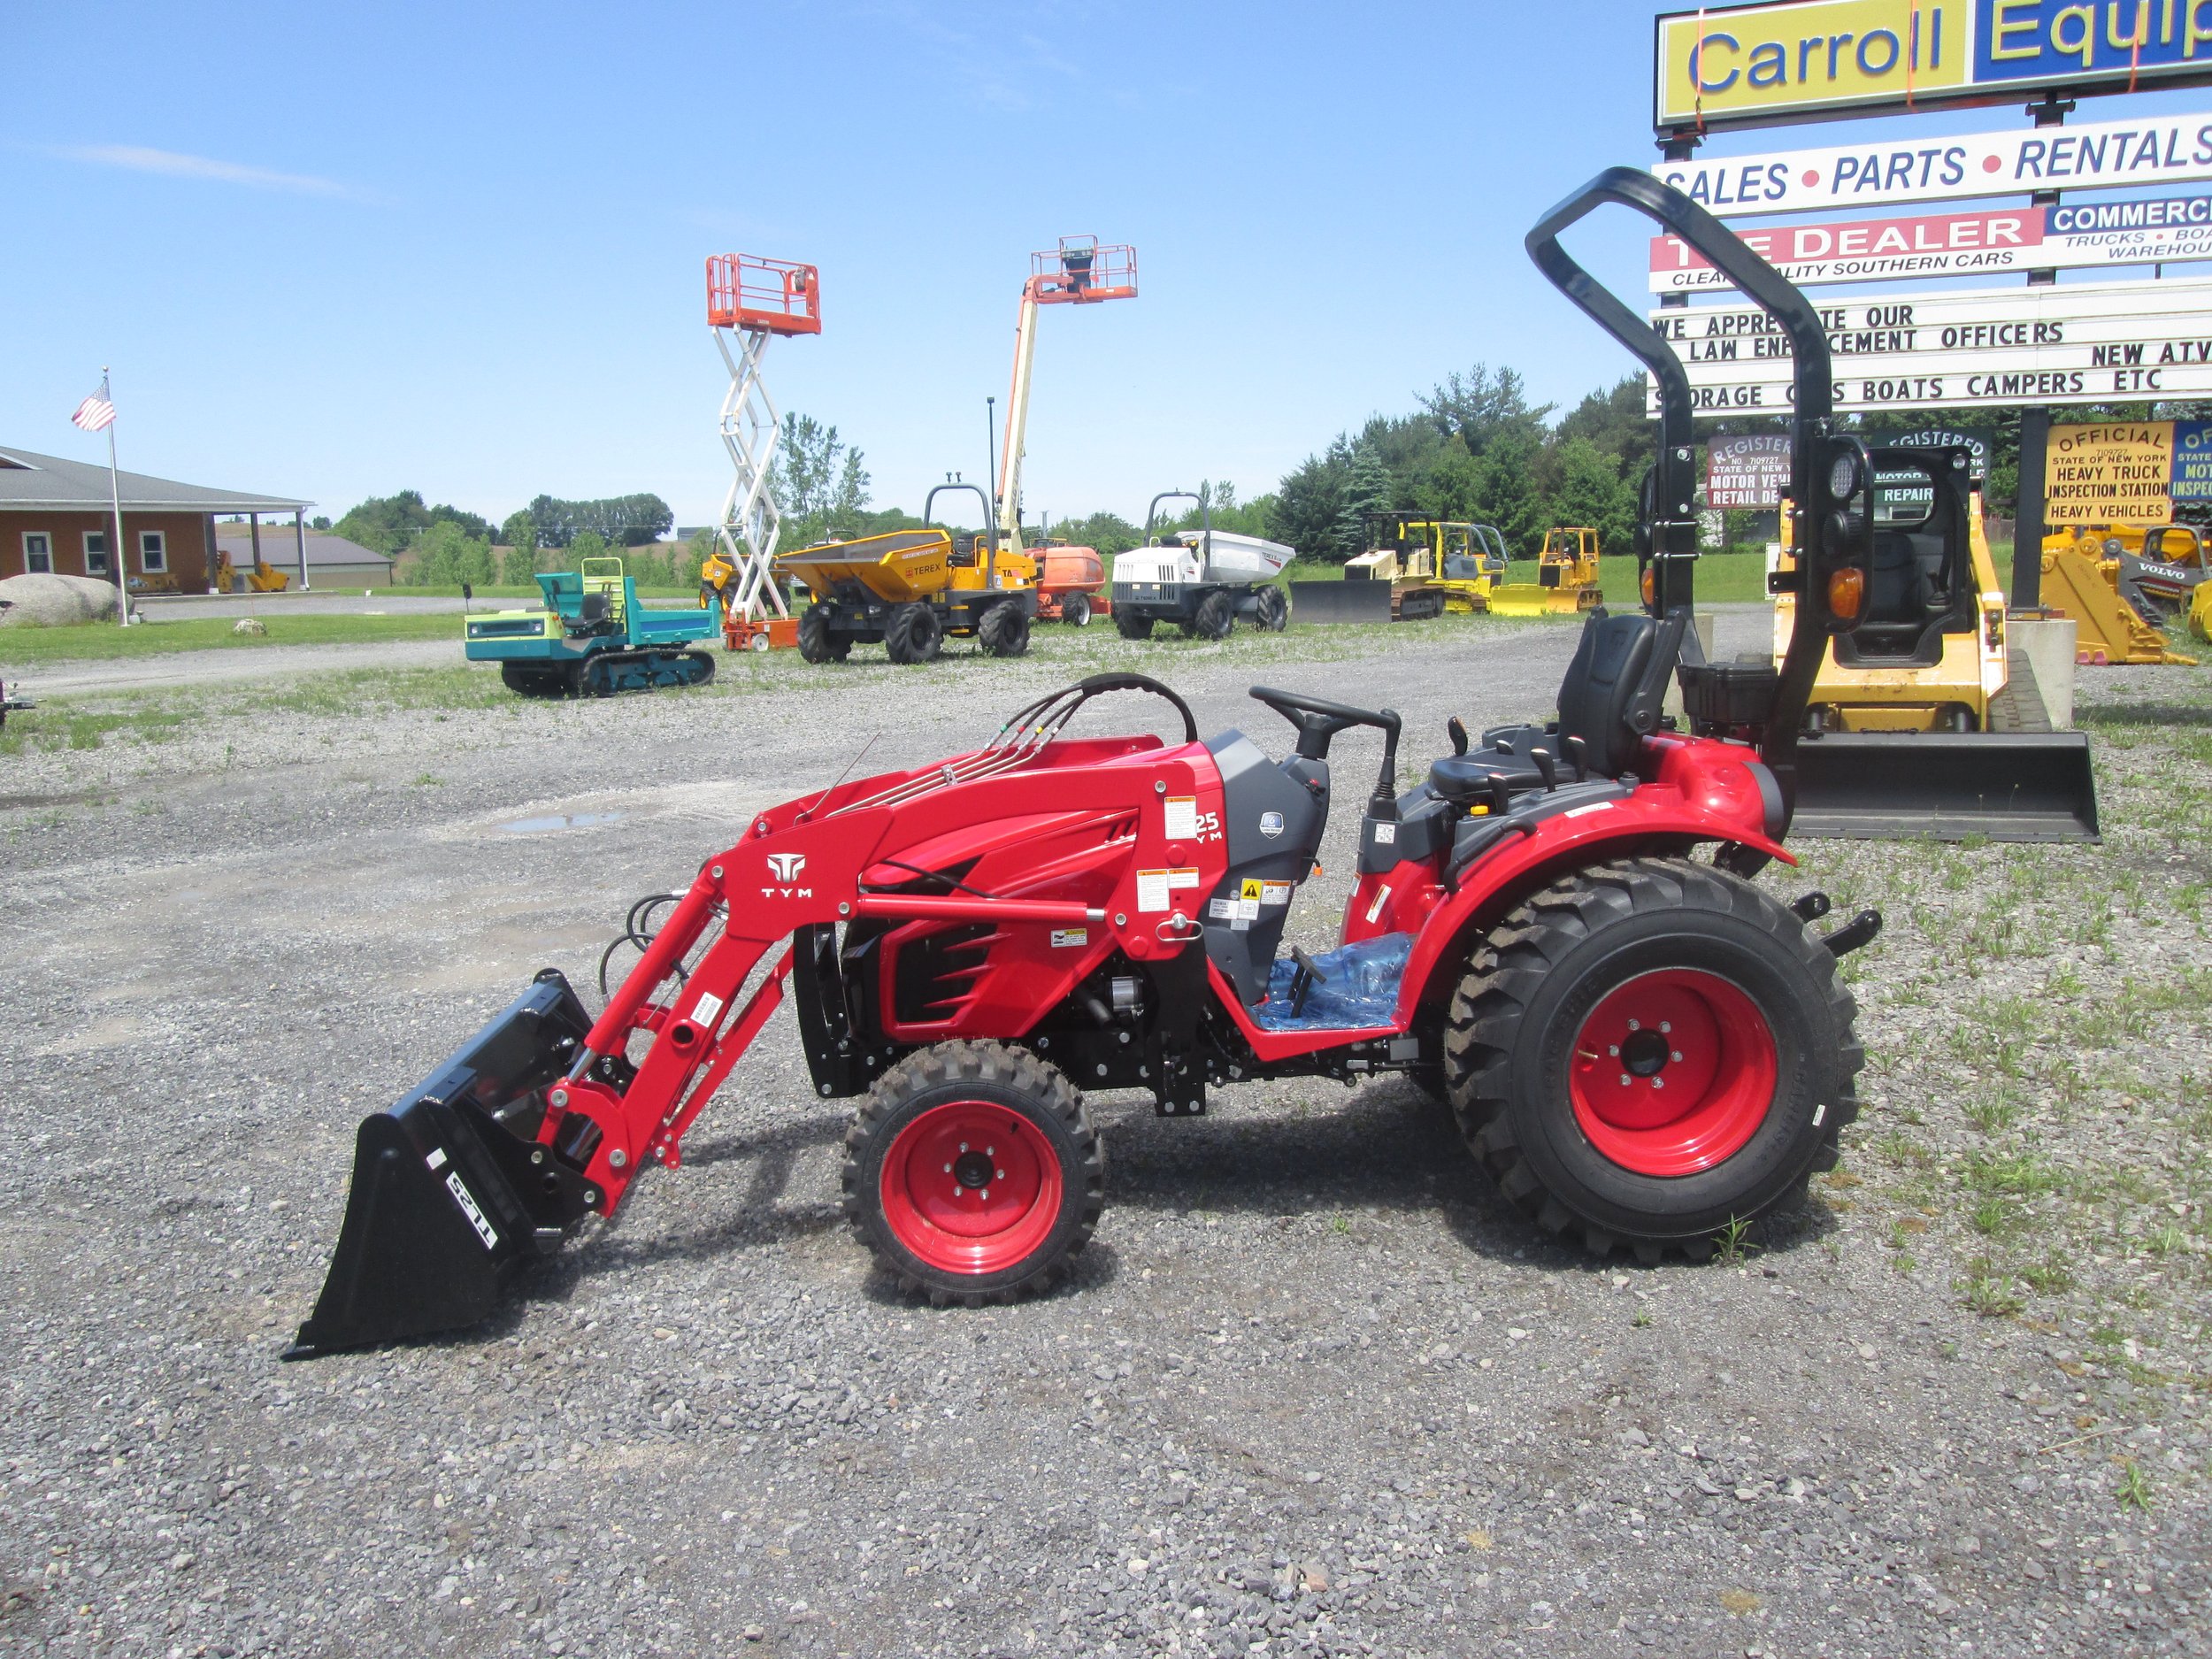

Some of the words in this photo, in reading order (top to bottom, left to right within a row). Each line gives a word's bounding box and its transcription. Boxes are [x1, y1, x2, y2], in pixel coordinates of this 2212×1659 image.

[1688, 7, 1942, 92] Carroll
[1832, 147, 1967, 195] PARTS
[2015, 125, 2212, 180] RENTALS
[1668, 236, 1772, 266] TE
[1793, 218, 2023, 259] DEALER
[2065, 232, 2145, 248] TRUCKS
[2108, 242, 2212, 258] WAREHOU
[1672, 272, 1727, 286] CLEA
[1833, 255, 1949, 275] SOUTHERN
[1955, 251, 2014, 266] CARS
[1652, 319, 1686, 338] WE
[1707, 310, 1846, 336] APPRETE
[1866, 305, 1913, 326] OUR
[1690, 339, 1737, 360] LAW
[1941, 322, 2063, 348] OFFICERS
[2092, 343, 2144, 366] NEW
[2159, 341, 2212, 363] ATV
[1863, 378, 1943, 401] BOATS
[1967, 372, 2084, 396] CAMPERS
[2114, 368, 2162, 390] ETC
[2059, 427, 2164, 452] OFFICIAL
[1713, 437, 1791, 465] REGISTER
[2108, 455, 2132, 464] NEW
[2137, 454, 2167, 463] YORK
[2178, 452, 2212, 461] STATE
[2057, 466, 2104, 481] HEAVY
[2112, 465, 2161, 480] TRUCK
[1710, 474, 1755, 489] MOTOR
[1713, 490, 1757, 504] RETAIL
[1884, 488, 1934, 502] REPAIR
[2048, 483, 2116, 498] INSPECTION
[2120, 482, 2169, 496] STATION
[2051, 505, 2093, 518] HEAVY
[2100, 504, 2163, 518] VEHICLES
[914, 564, 941, 575] TEREX
[2139, 562, 2185, 580] VOLVO
[1196, 831, 1223, 844] YM
[761, 887, 812, 898] TYM
[449, 1177, 490, 1243] TL25
